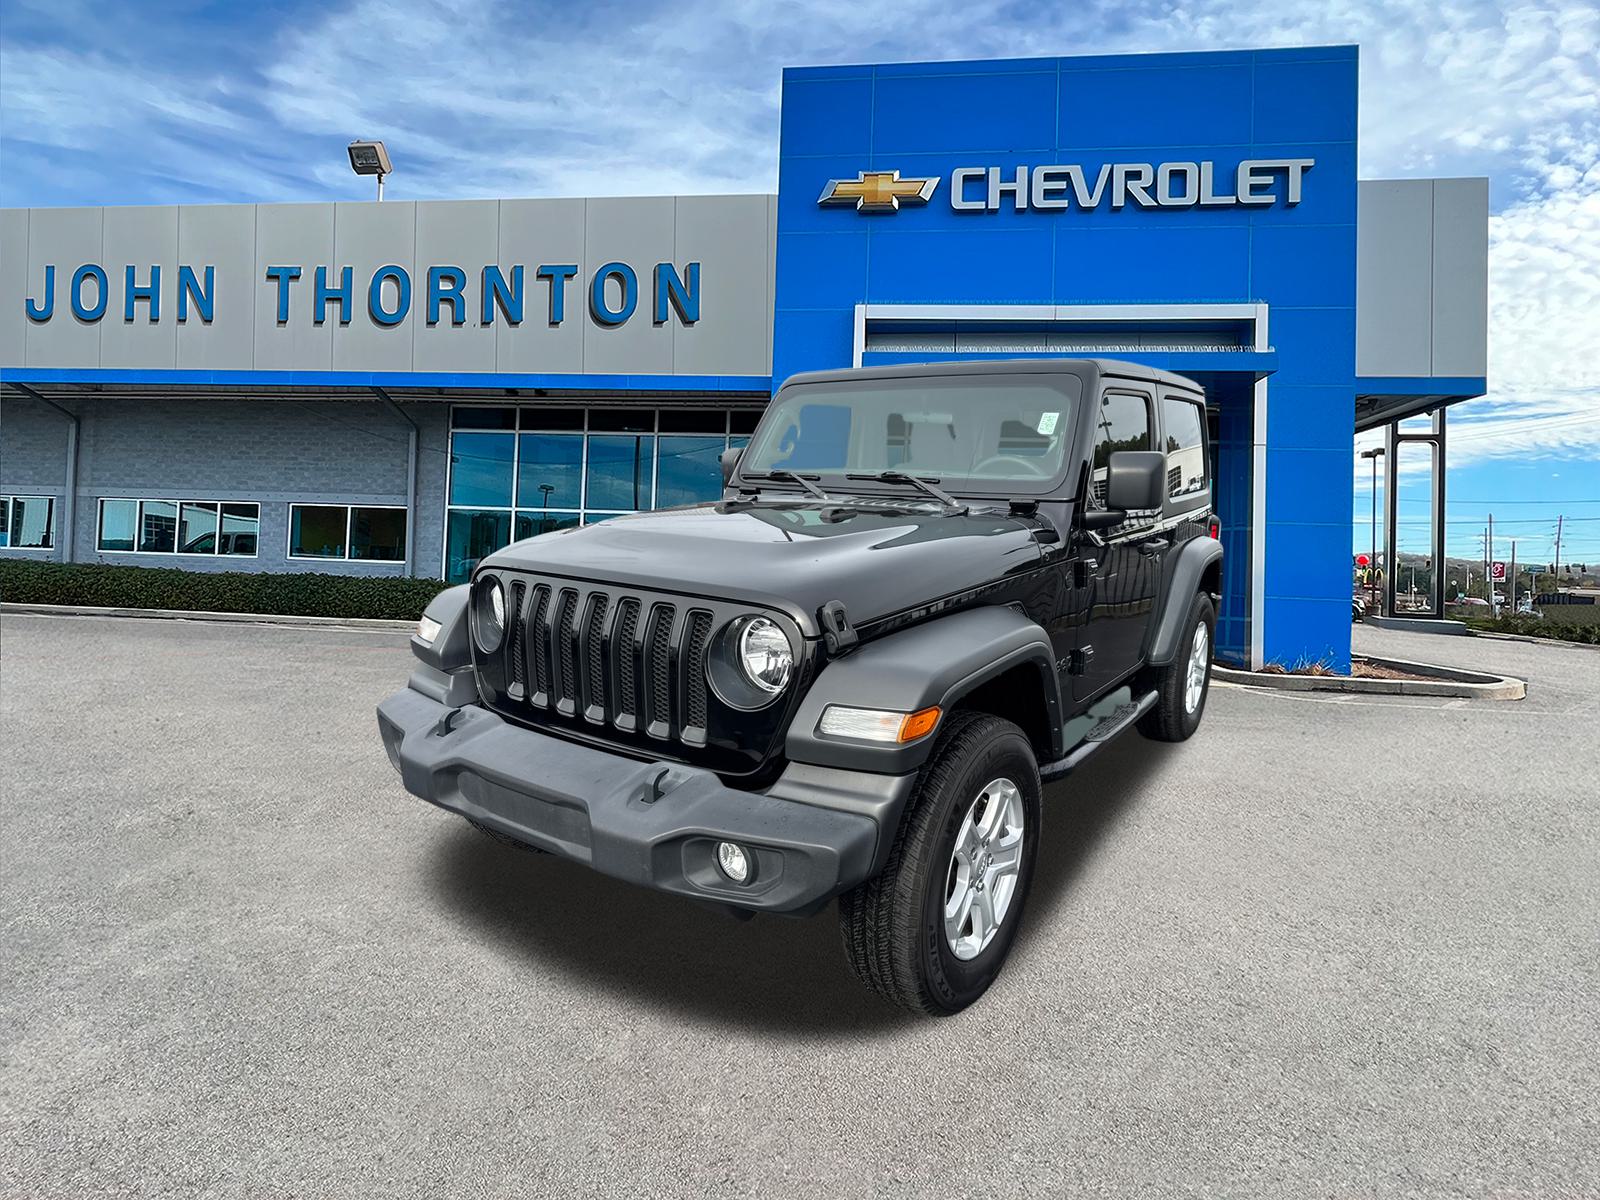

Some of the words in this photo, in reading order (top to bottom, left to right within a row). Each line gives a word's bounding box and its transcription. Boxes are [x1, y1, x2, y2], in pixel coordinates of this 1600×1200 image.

[951, 157, 1316, 211] CHEVROLET
[25, 263, 216, 325] JOHN
[265, 262, 703, 327] THORNTON
